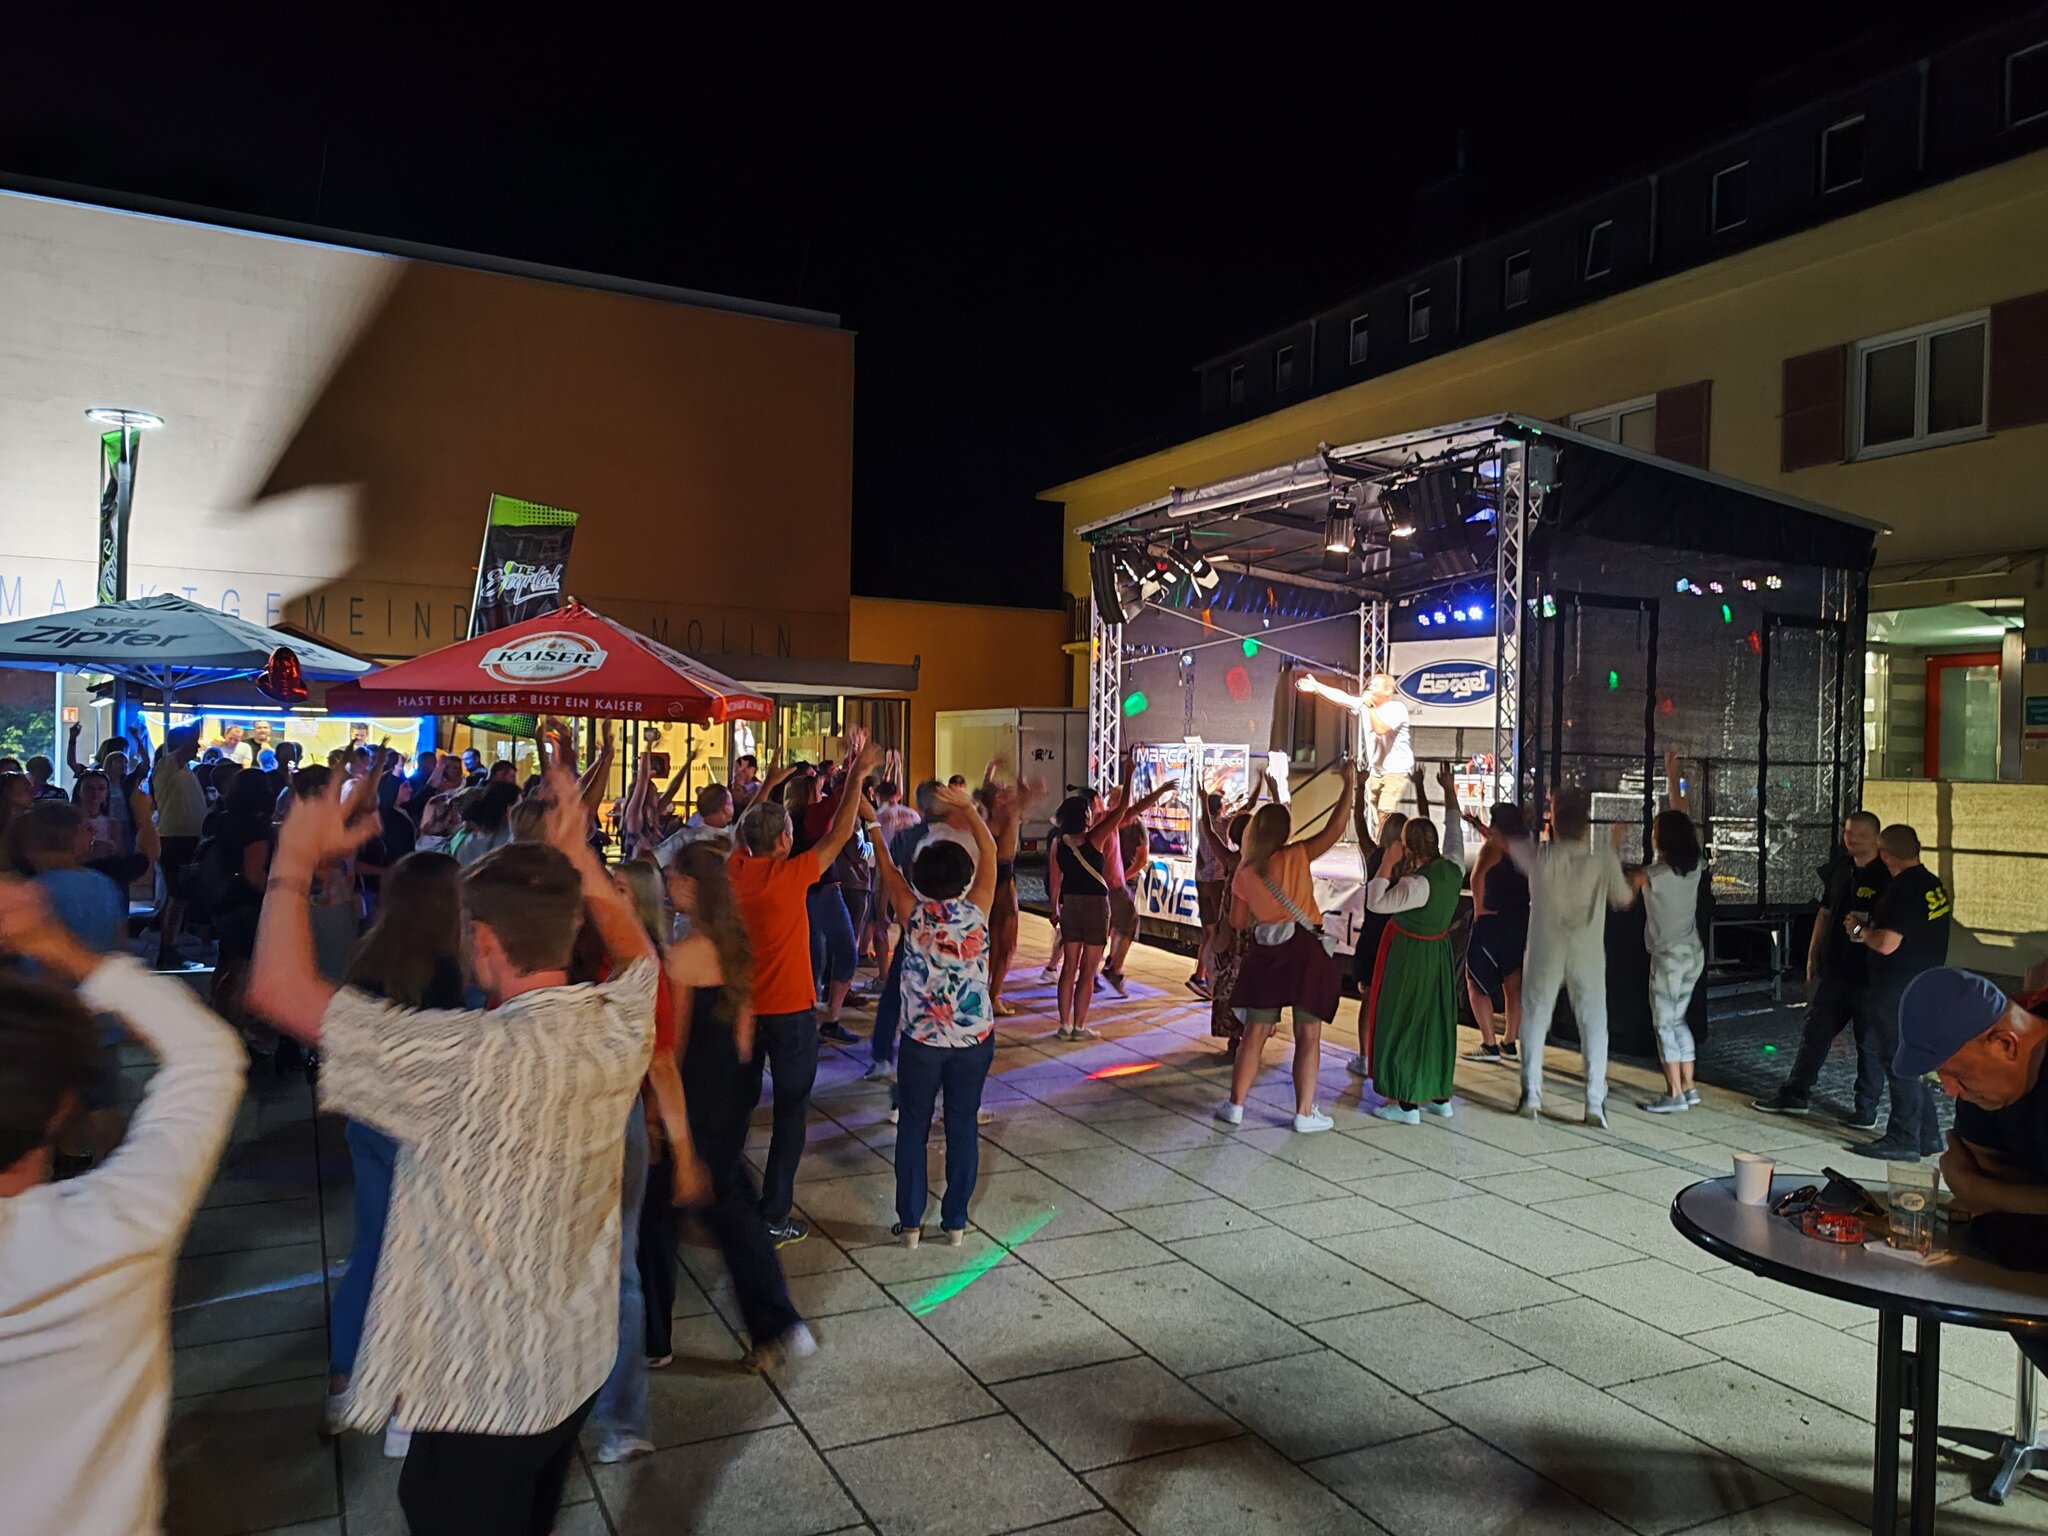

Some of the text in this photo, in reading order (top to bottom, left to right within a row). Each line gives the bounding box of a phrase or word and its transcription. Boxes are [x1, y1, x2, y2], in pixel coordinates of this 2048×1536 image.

[14, 625, 190, 649] Zipfer
[496, 650, 593, 664] KAISER
[397, 695, 433, 706] HAST
[439, 695, 463, 706] EIN
[468, 693, 518, 705] KAISER
[530, 694, 560, 707] BIST
[565, 696, 590, 708] EIN
[595, 698, 643, 712] KAISER
